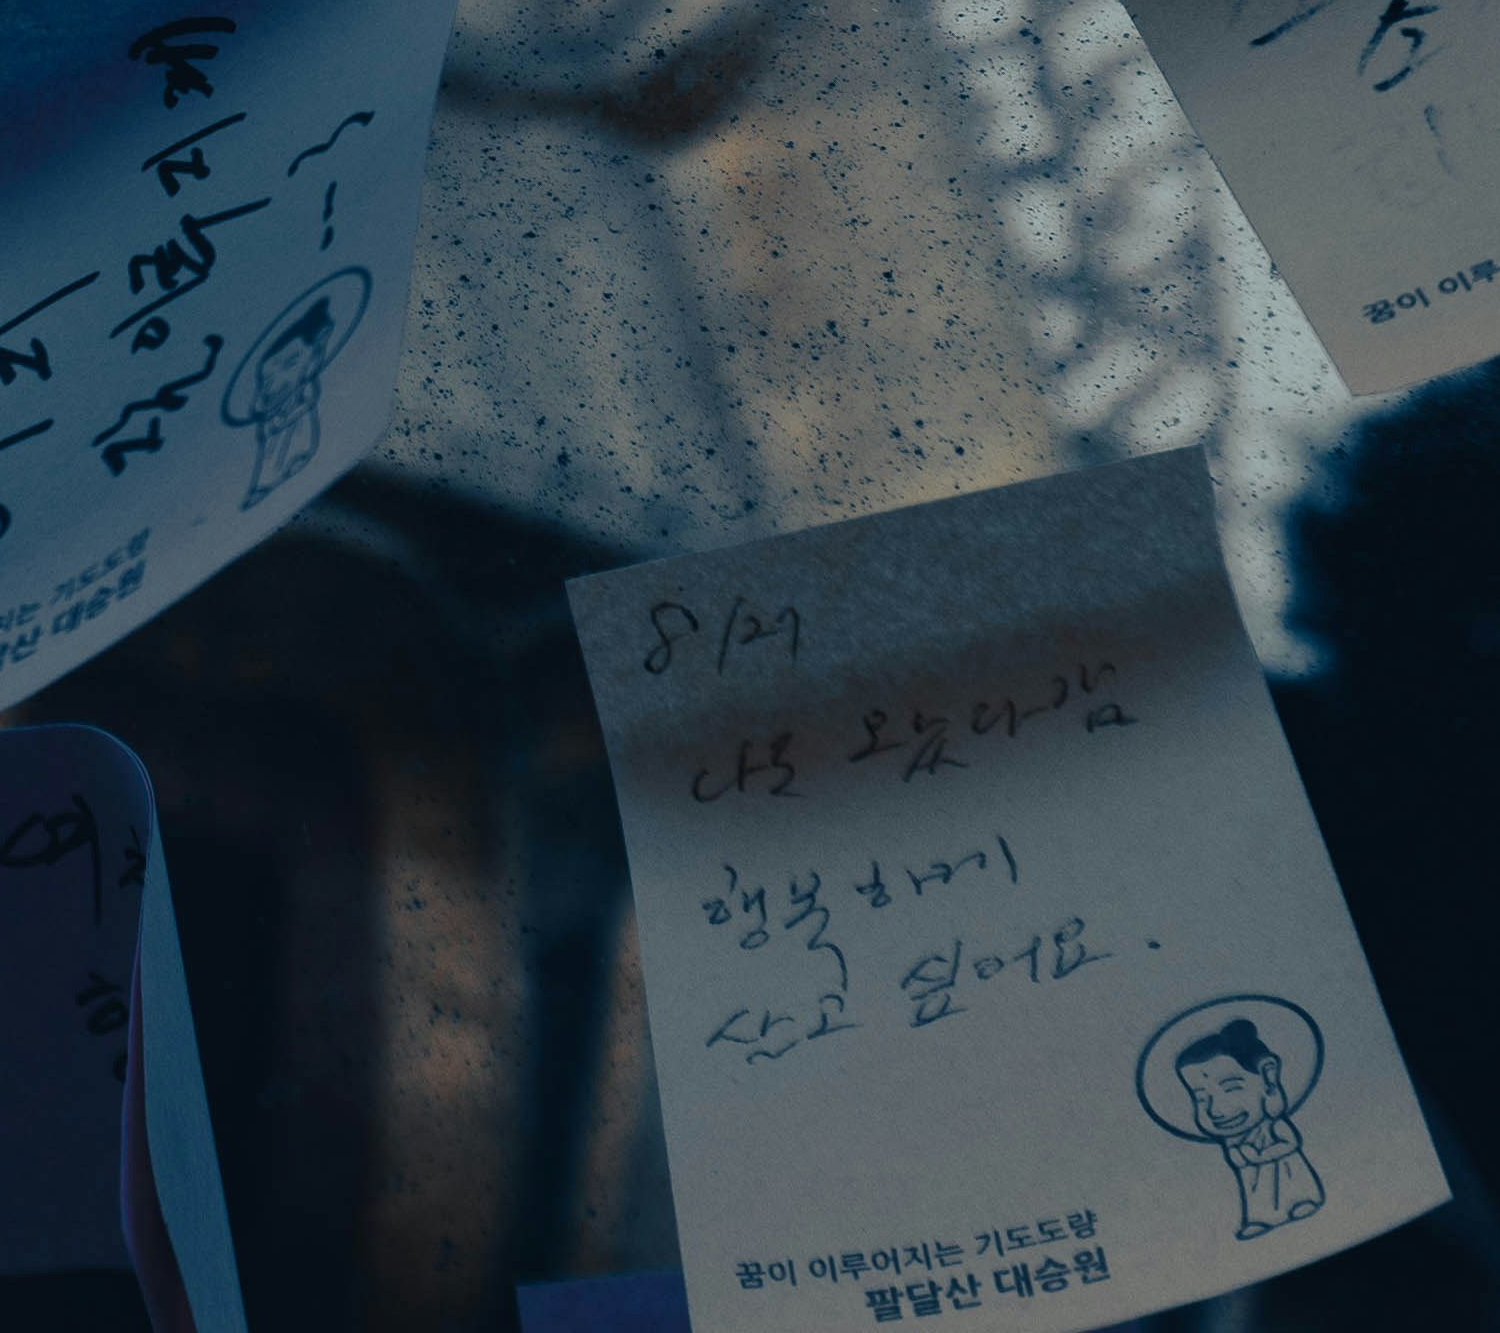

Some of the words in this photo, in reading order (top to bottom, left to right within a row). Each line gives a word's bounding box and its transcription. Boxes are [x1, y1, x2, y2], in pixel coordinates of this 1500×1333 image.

[1361, 286, 1432, 326] 꿈이
[733, 1253, 803, 1293] 꿈이
[806, 1233, 967, 1285] 이루어지는
[973, 1207, 1102, 1260] 기도도량
[861, 1268, 986, 1327] 팔달산
[992, 1243, 1114, 1308] 대승원
